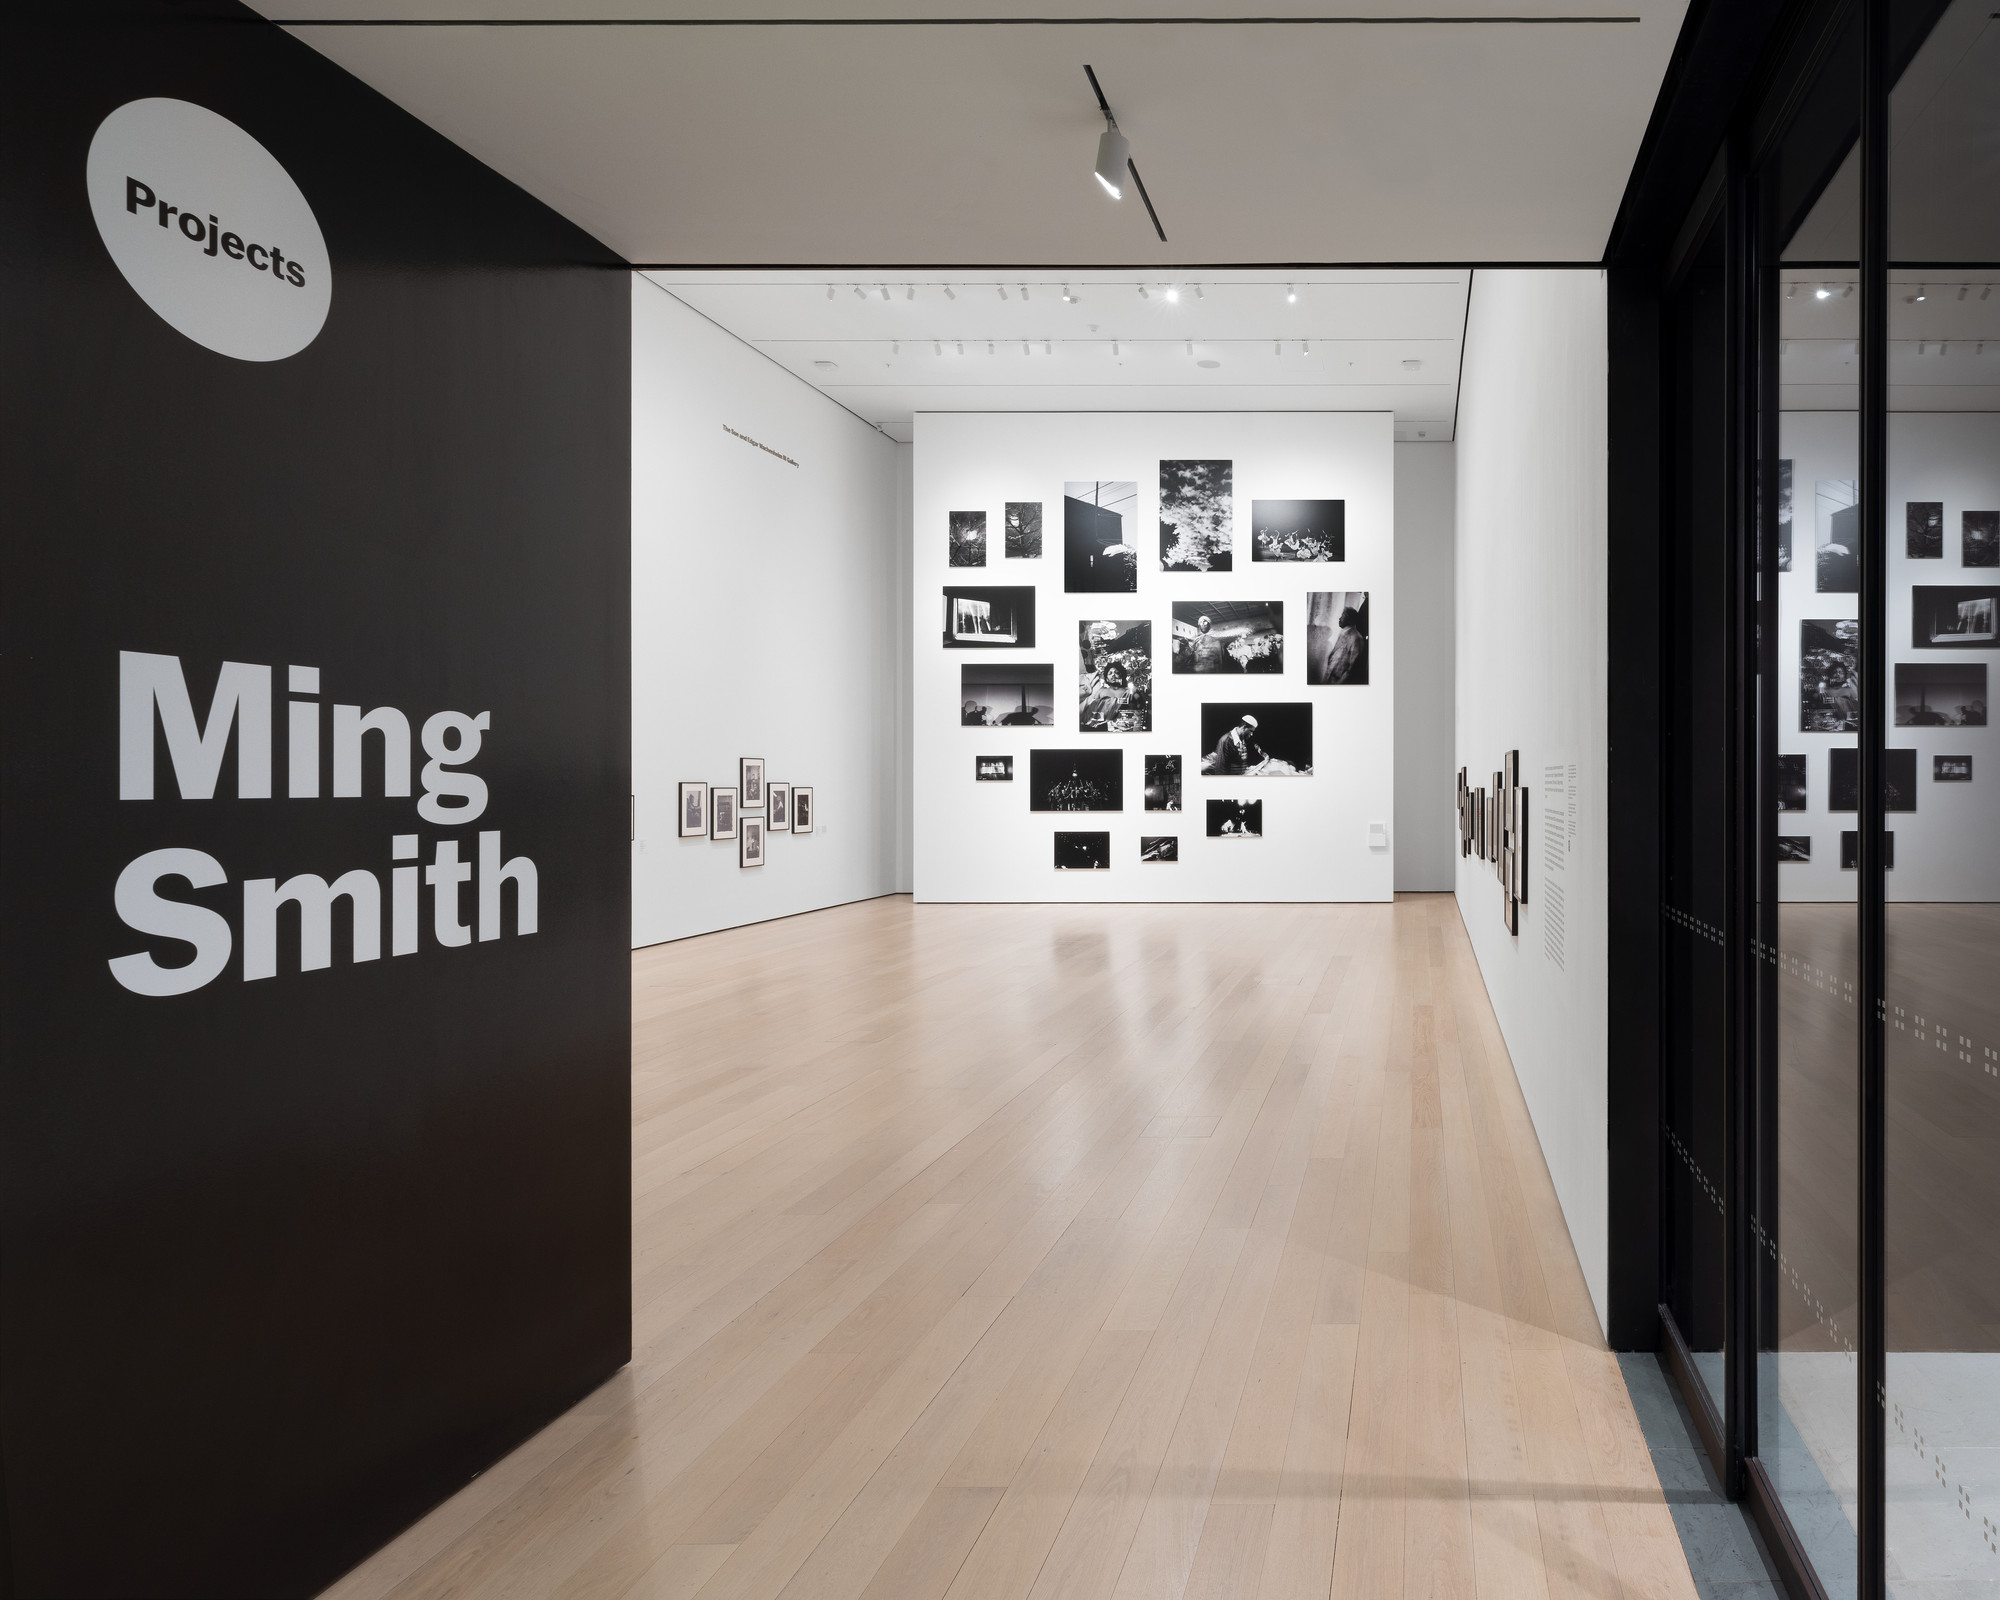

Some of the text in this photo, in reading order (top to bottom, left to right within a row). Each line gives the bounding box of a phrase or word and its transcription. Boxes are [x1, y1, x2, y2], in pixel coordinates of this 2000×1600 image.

[126, 175, 306, 288] Projects
[119, 651, 491, 826] Ming
[107, 830, 539, 997] Smith
